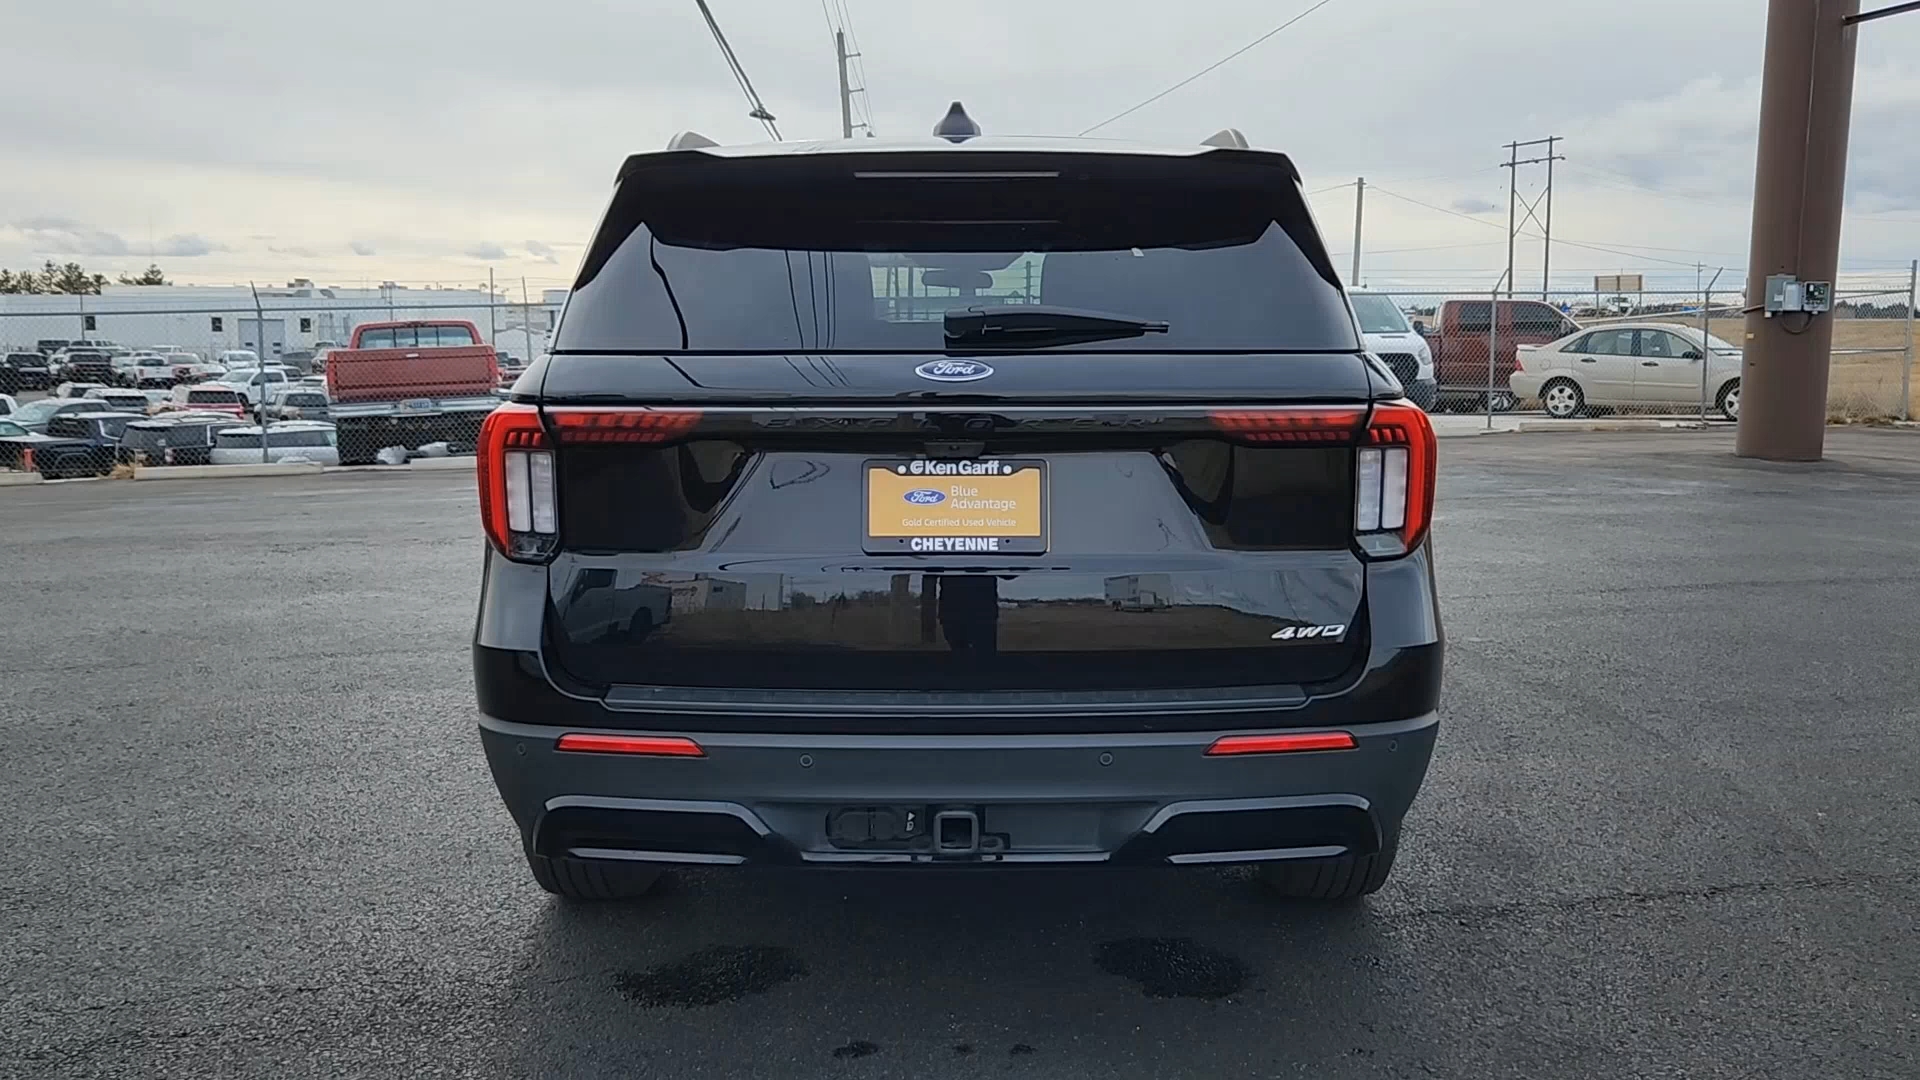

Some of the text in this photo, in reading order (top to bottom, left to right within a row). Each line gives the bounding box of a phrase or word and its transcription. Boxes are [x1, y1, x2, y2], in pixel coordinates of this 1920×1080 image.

[933, 362, 975, 375] Ford
[925, 461, 957, 475] Ken
[958, 461, 1000, 475] Garff
[910, 491, 938, 503] Ford
[951, 486, 978, 497] Blue
[950, 499, 1016, 511] Advantage
[902, 518, 1017, 527] Gold Certified Used Vehicle
[910, 537, 999, 551] CHEYENNE
[1271, 624, 1346, 639] 4WD
